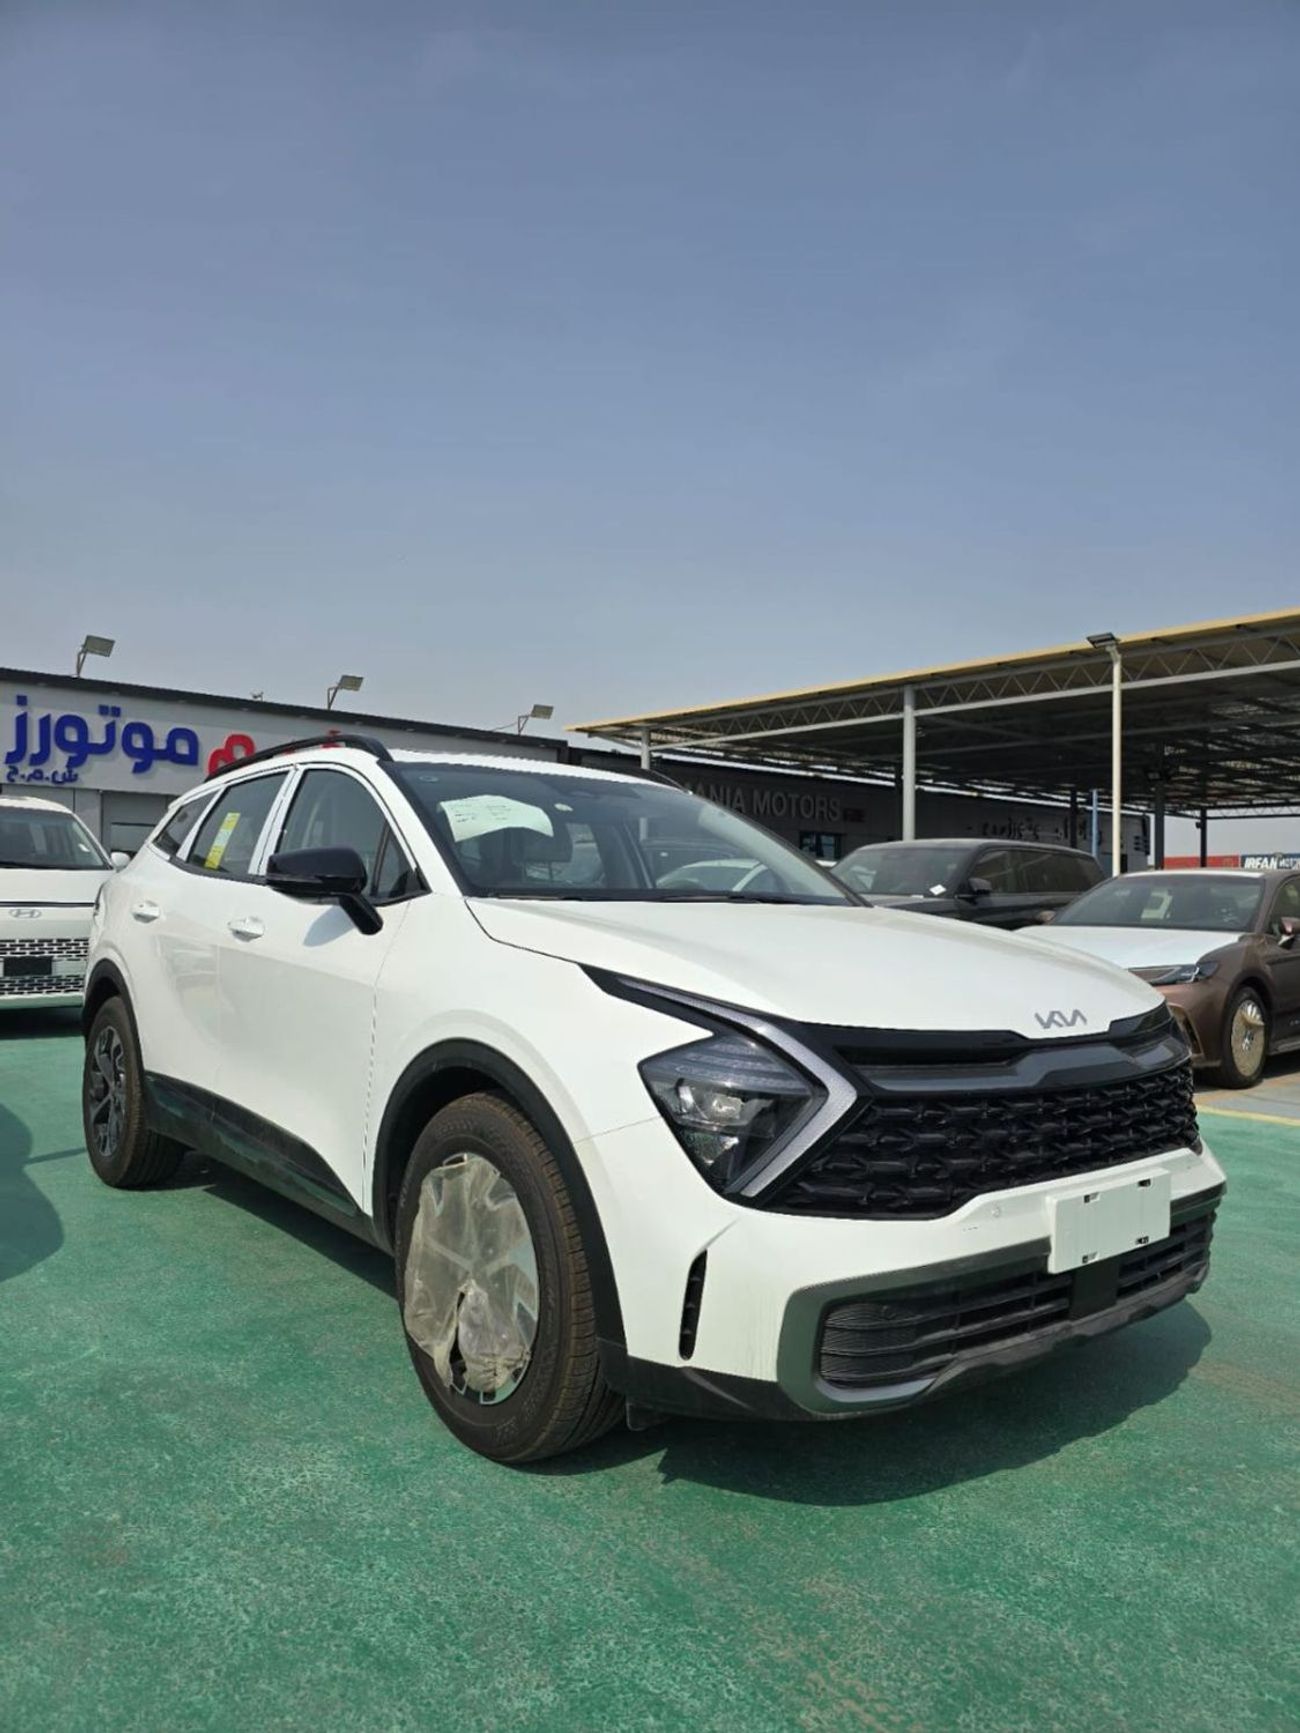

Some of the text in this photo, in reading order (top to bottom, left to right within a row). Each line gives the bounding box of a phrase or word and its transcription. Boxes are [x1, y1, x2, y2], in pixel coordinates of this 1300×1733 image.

[5, 695, 199, 774] موتورز
[752, 788, 841, 823] MOTORS
[1243, 856, 1278, 869] IRFAN
[1034, 1008, 1088, 1029] KIA
